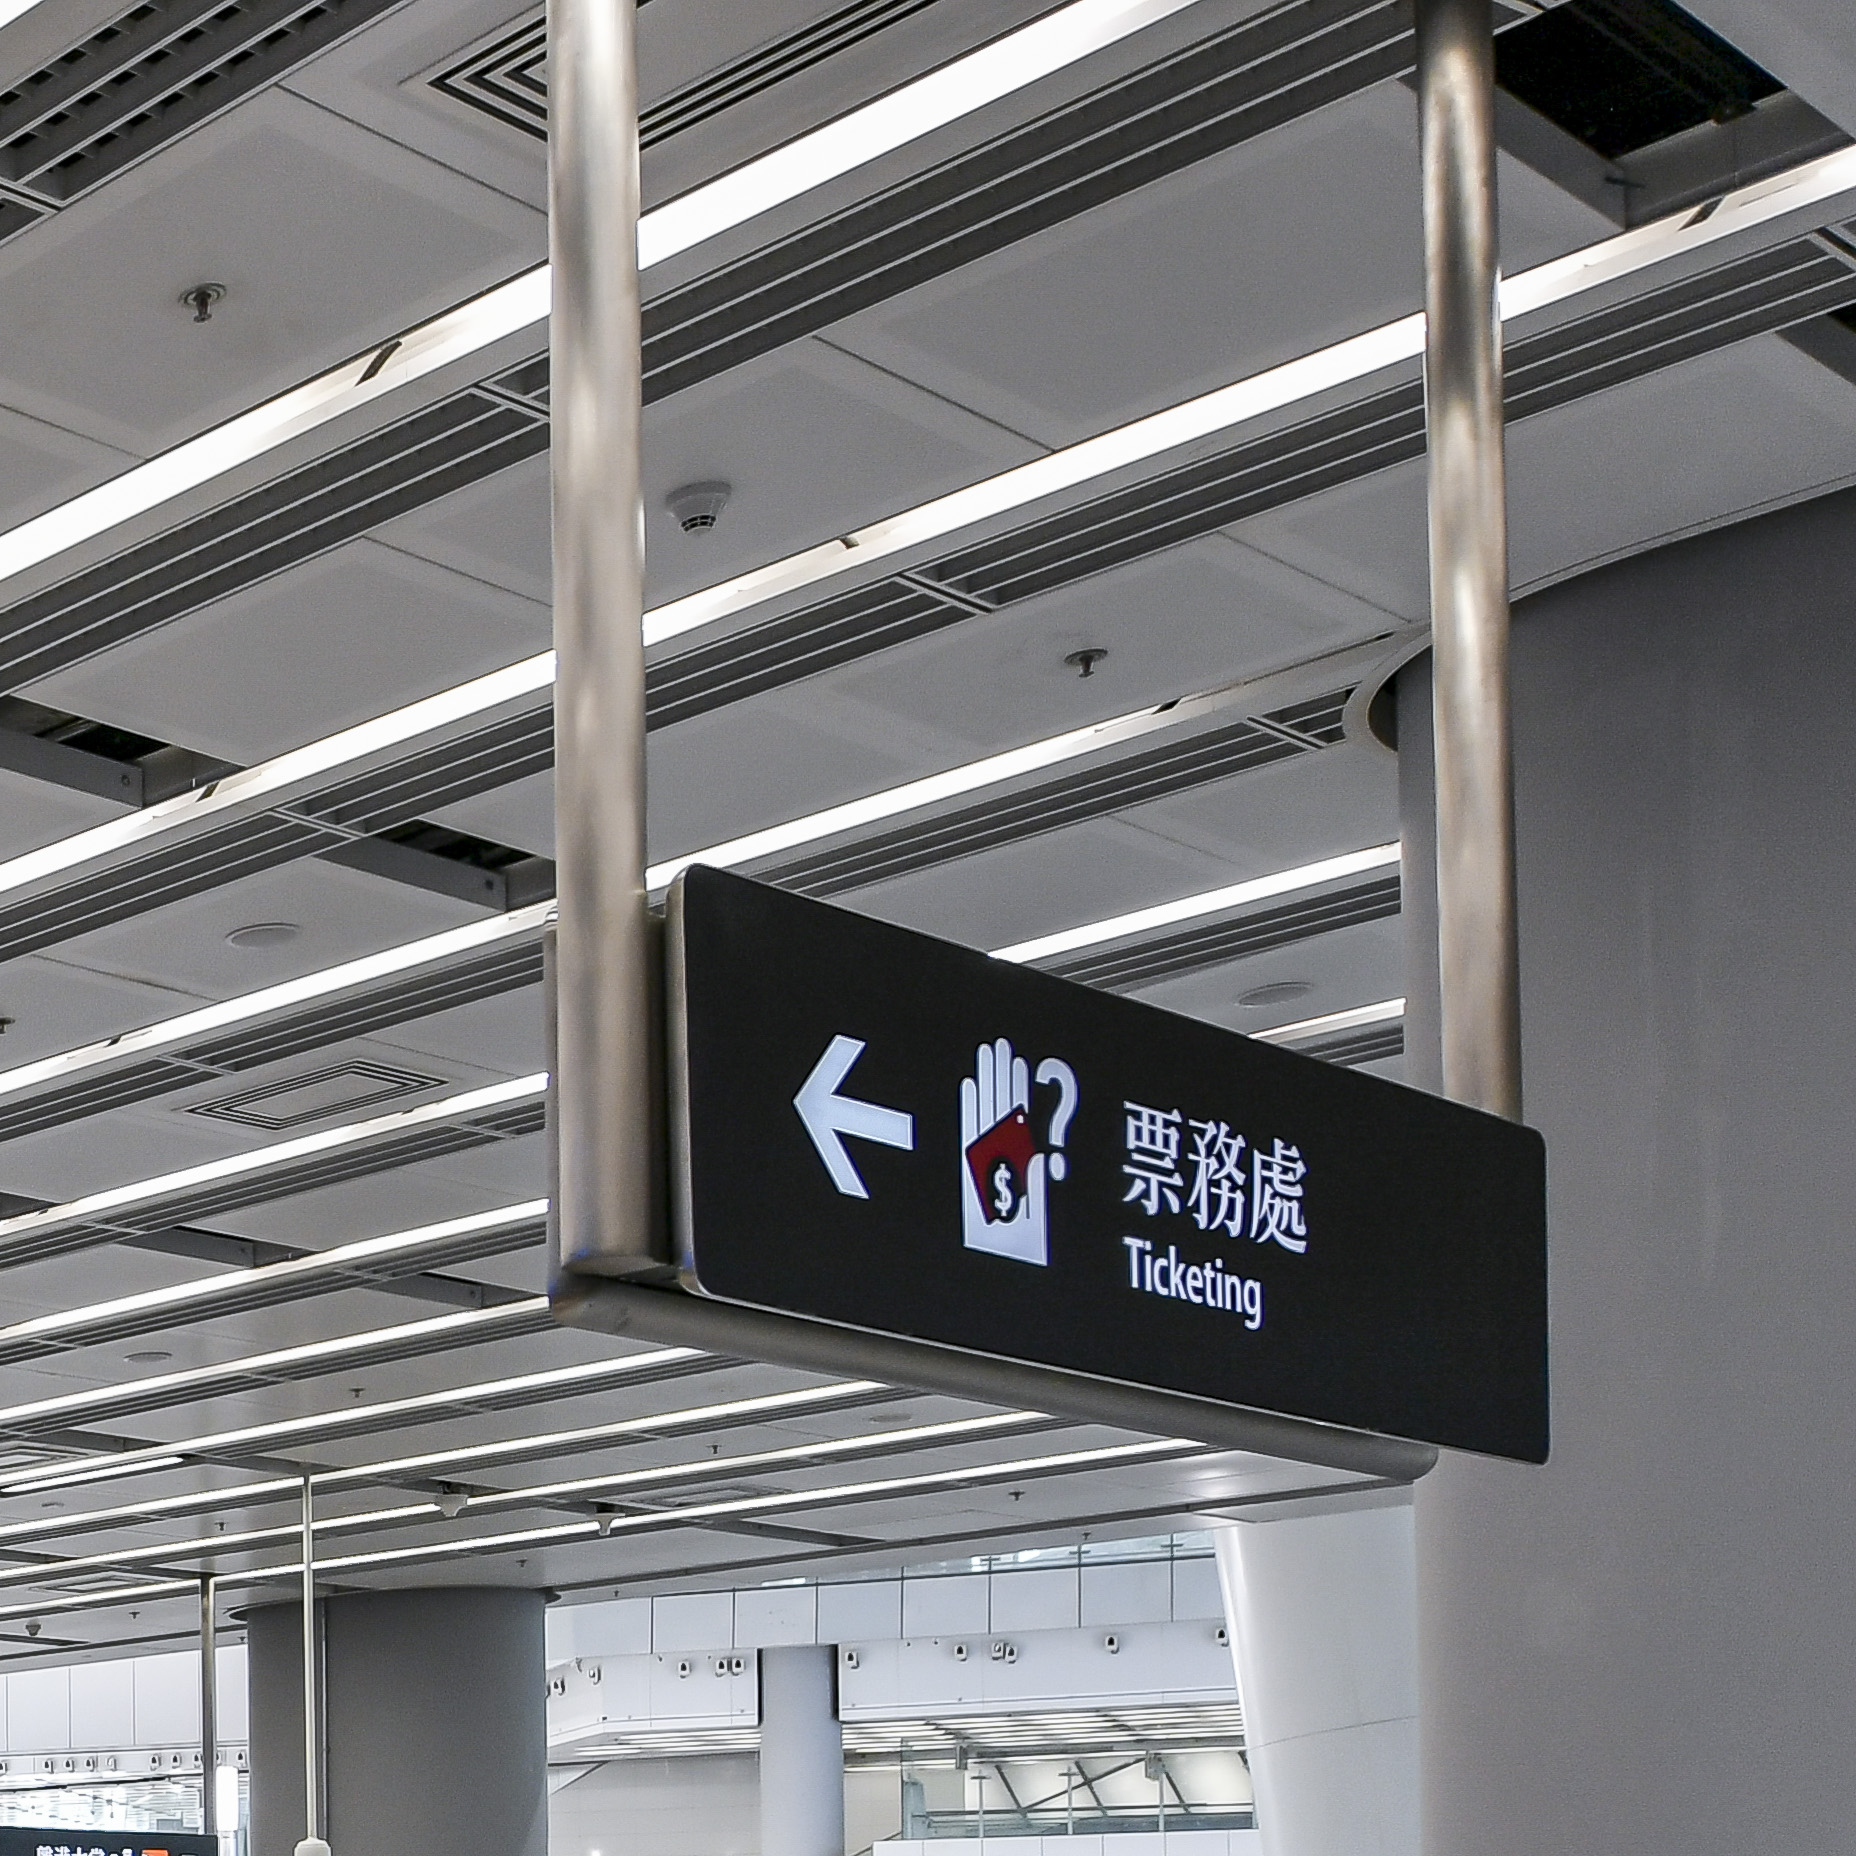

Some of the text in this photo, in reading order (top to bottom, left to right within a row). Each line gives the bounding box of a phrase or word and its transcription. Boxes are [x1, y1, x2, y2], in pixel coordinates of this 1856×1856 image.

[1122, 1100, 1307, 1254] 票務處
[1122, 1235, 1263, 1331] Ticketing
